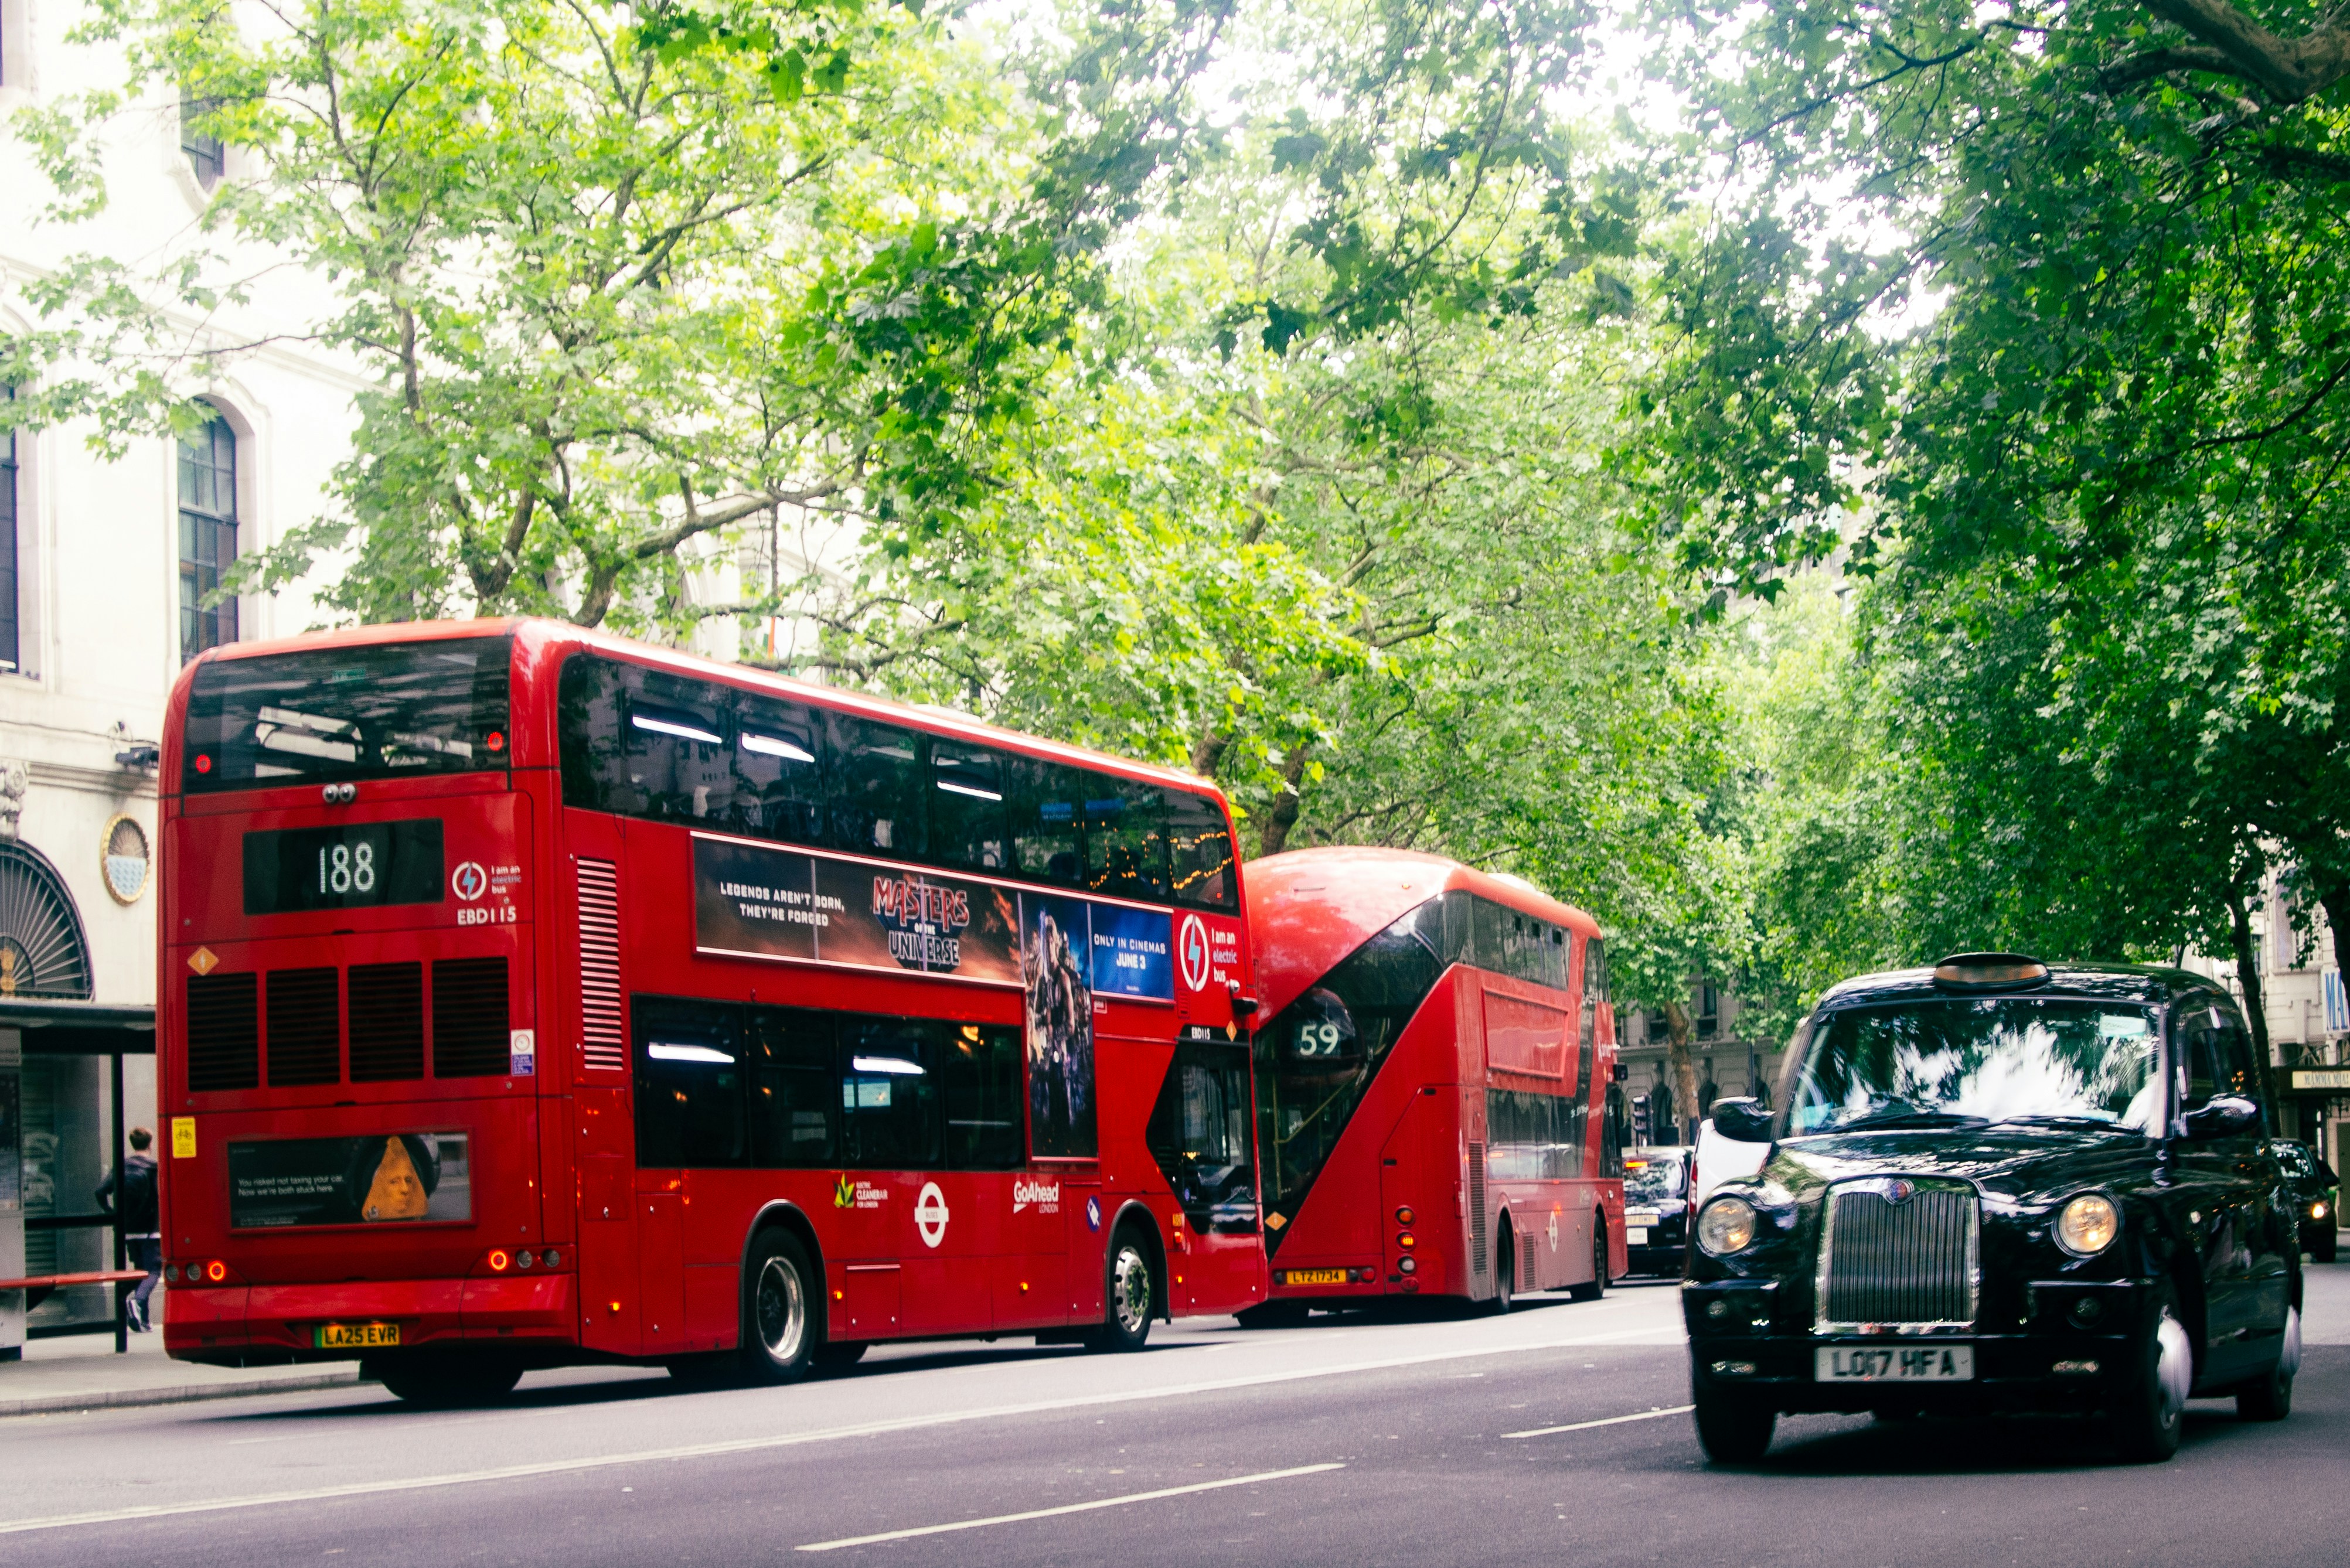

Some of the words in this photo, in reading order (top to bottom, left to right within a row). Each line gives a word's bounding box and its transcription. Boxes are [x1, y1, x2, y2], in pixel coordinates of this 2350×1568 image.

[320, 841, 374, 894] 188
[491, 865, 495, 875] I
[496, 865, 508, 874] am
[510, 865, 520, 874] an
[492, 875, 522, 884] electric
[491, 885, 506, 894] bus
[720, 881, 769, 901] LEGENDS
[773, 889, 811, 906] AREN'T
[813, 894, 845, 912] BORN,
[873, 876, 969, 933] MASTERS
[457, 905, 516, 925] EBD115
[740, 903, 785, 921] THEY'RE
[788, 909, 829, 926] FORGED
[1094, 933, 1115, 947] ONLY
[1118, 938, 1126, 948] IN
[1129, 939, 1166, 955] CINEMAS
[1211, 927, 1215, 943] I
[1215, 930, 1225, 944] am
[1227, 932, 1235, 945] an
[888, 930, 961, 966] UNIVERSE
[1213, 948, 1237, 964] electric
[1116, 952, 1138, 969] JUNE
[1140, 954, 1146, 970] 3
[1213, 966, 1226, 983] bus
[1191, 1027, 1211, 1041] EBD115
[1300, 1024, 1339, 1055] 59
[239, 1178, 252, 1187] You
[277, 1177, 289, 1185] not
[314, 1175, 329, 1185] your
[238, 1188, 255, 1197] Now
[278, 1185, 294, 1194] both
[296, 1185, 315, 1194] stuck
[1014, 1180, 1060, 1203] GoAhead
[925, 1211, 938, 1219] BUSES
[1038, 1203, 1059, 1214] LONDON
[325, 1327, 363, 1345] LA25
[367, 1327, 397, 1343] EVR
[1899, 1349, 1956, 1376] HFA
